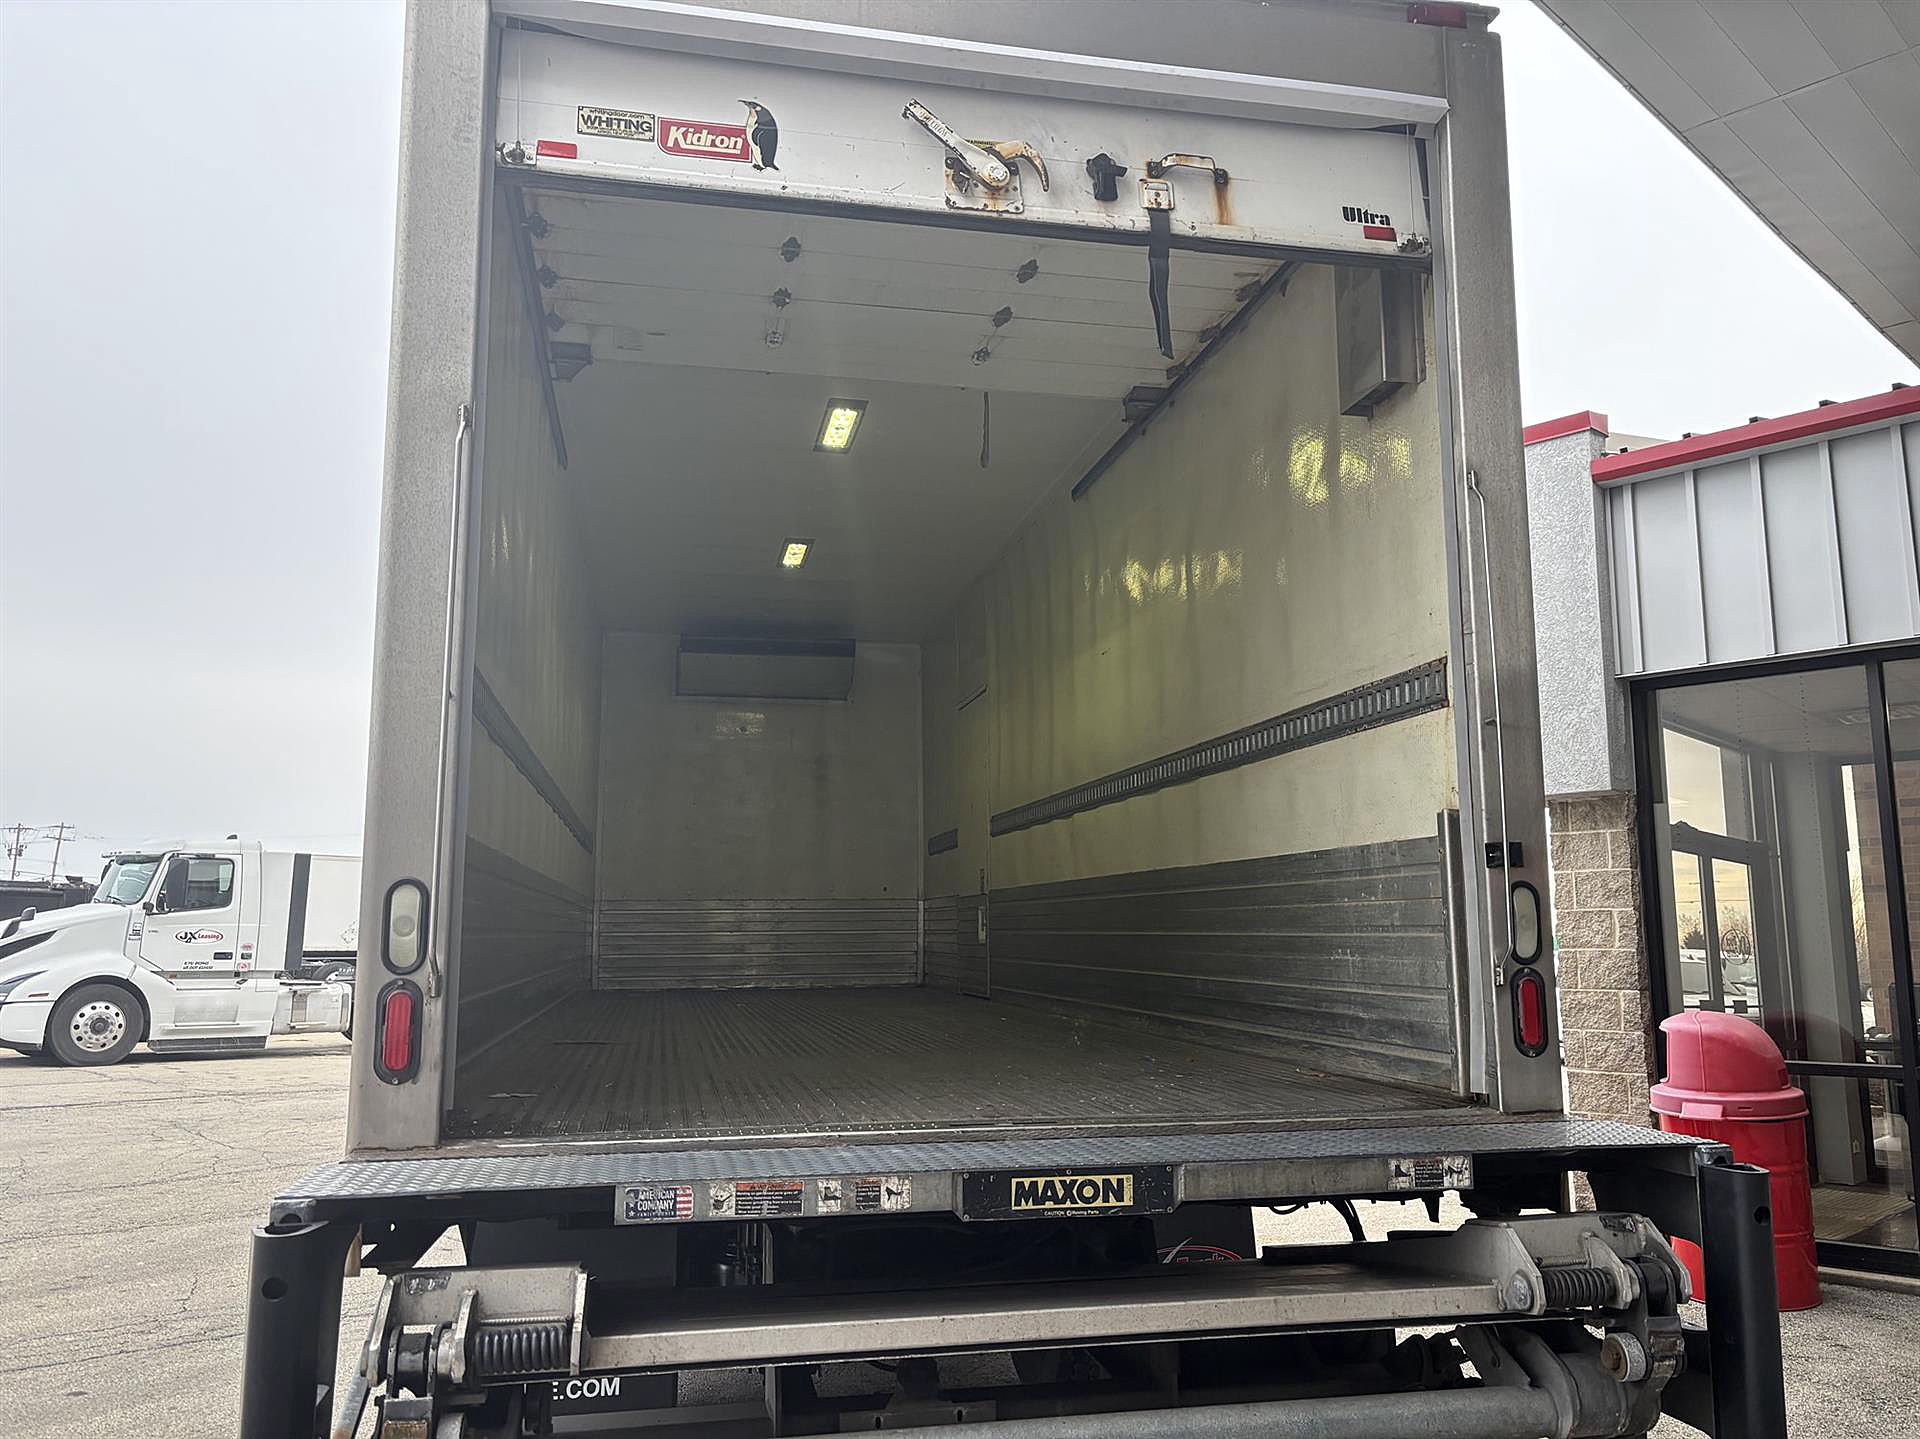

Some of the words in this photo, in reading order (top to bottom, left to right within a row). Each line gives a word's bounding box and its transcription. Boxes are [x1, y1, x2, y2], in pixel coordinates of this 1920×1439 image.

[580, 114, 653, 132] WHITING
[667, 126, 743, 154] Kidron
[1342, 206, 1391, 226] Ultra
[198, 932, 220, 940] Leasing
[1014, 1178, 1125, 1206] MAXON
